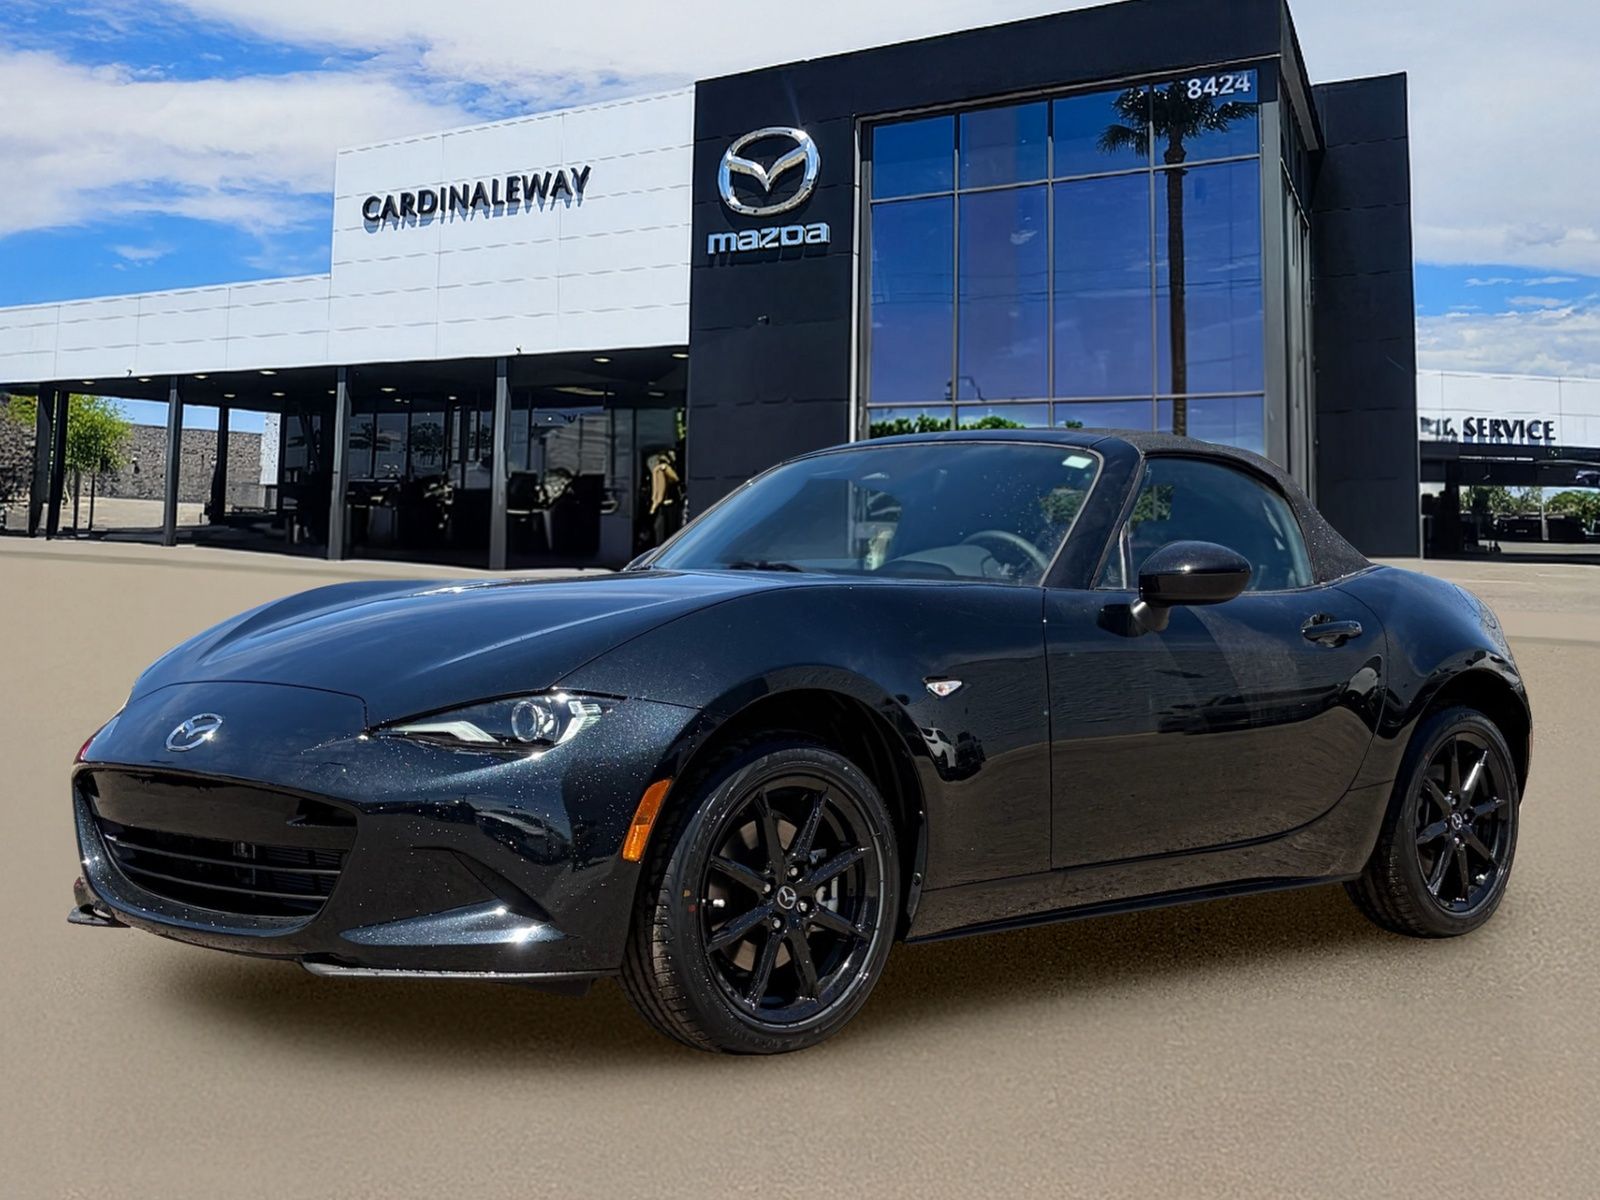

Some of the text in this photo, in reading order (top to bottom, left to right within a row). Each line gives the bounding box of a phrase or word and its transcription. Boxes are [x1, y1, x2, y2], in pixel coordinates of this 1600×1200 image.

[1187, 74, 1251, 99] 8424
[362, 165, 591, 222] CARDINALEWAY
[1463, 417, 1556, 440] SERVICE
